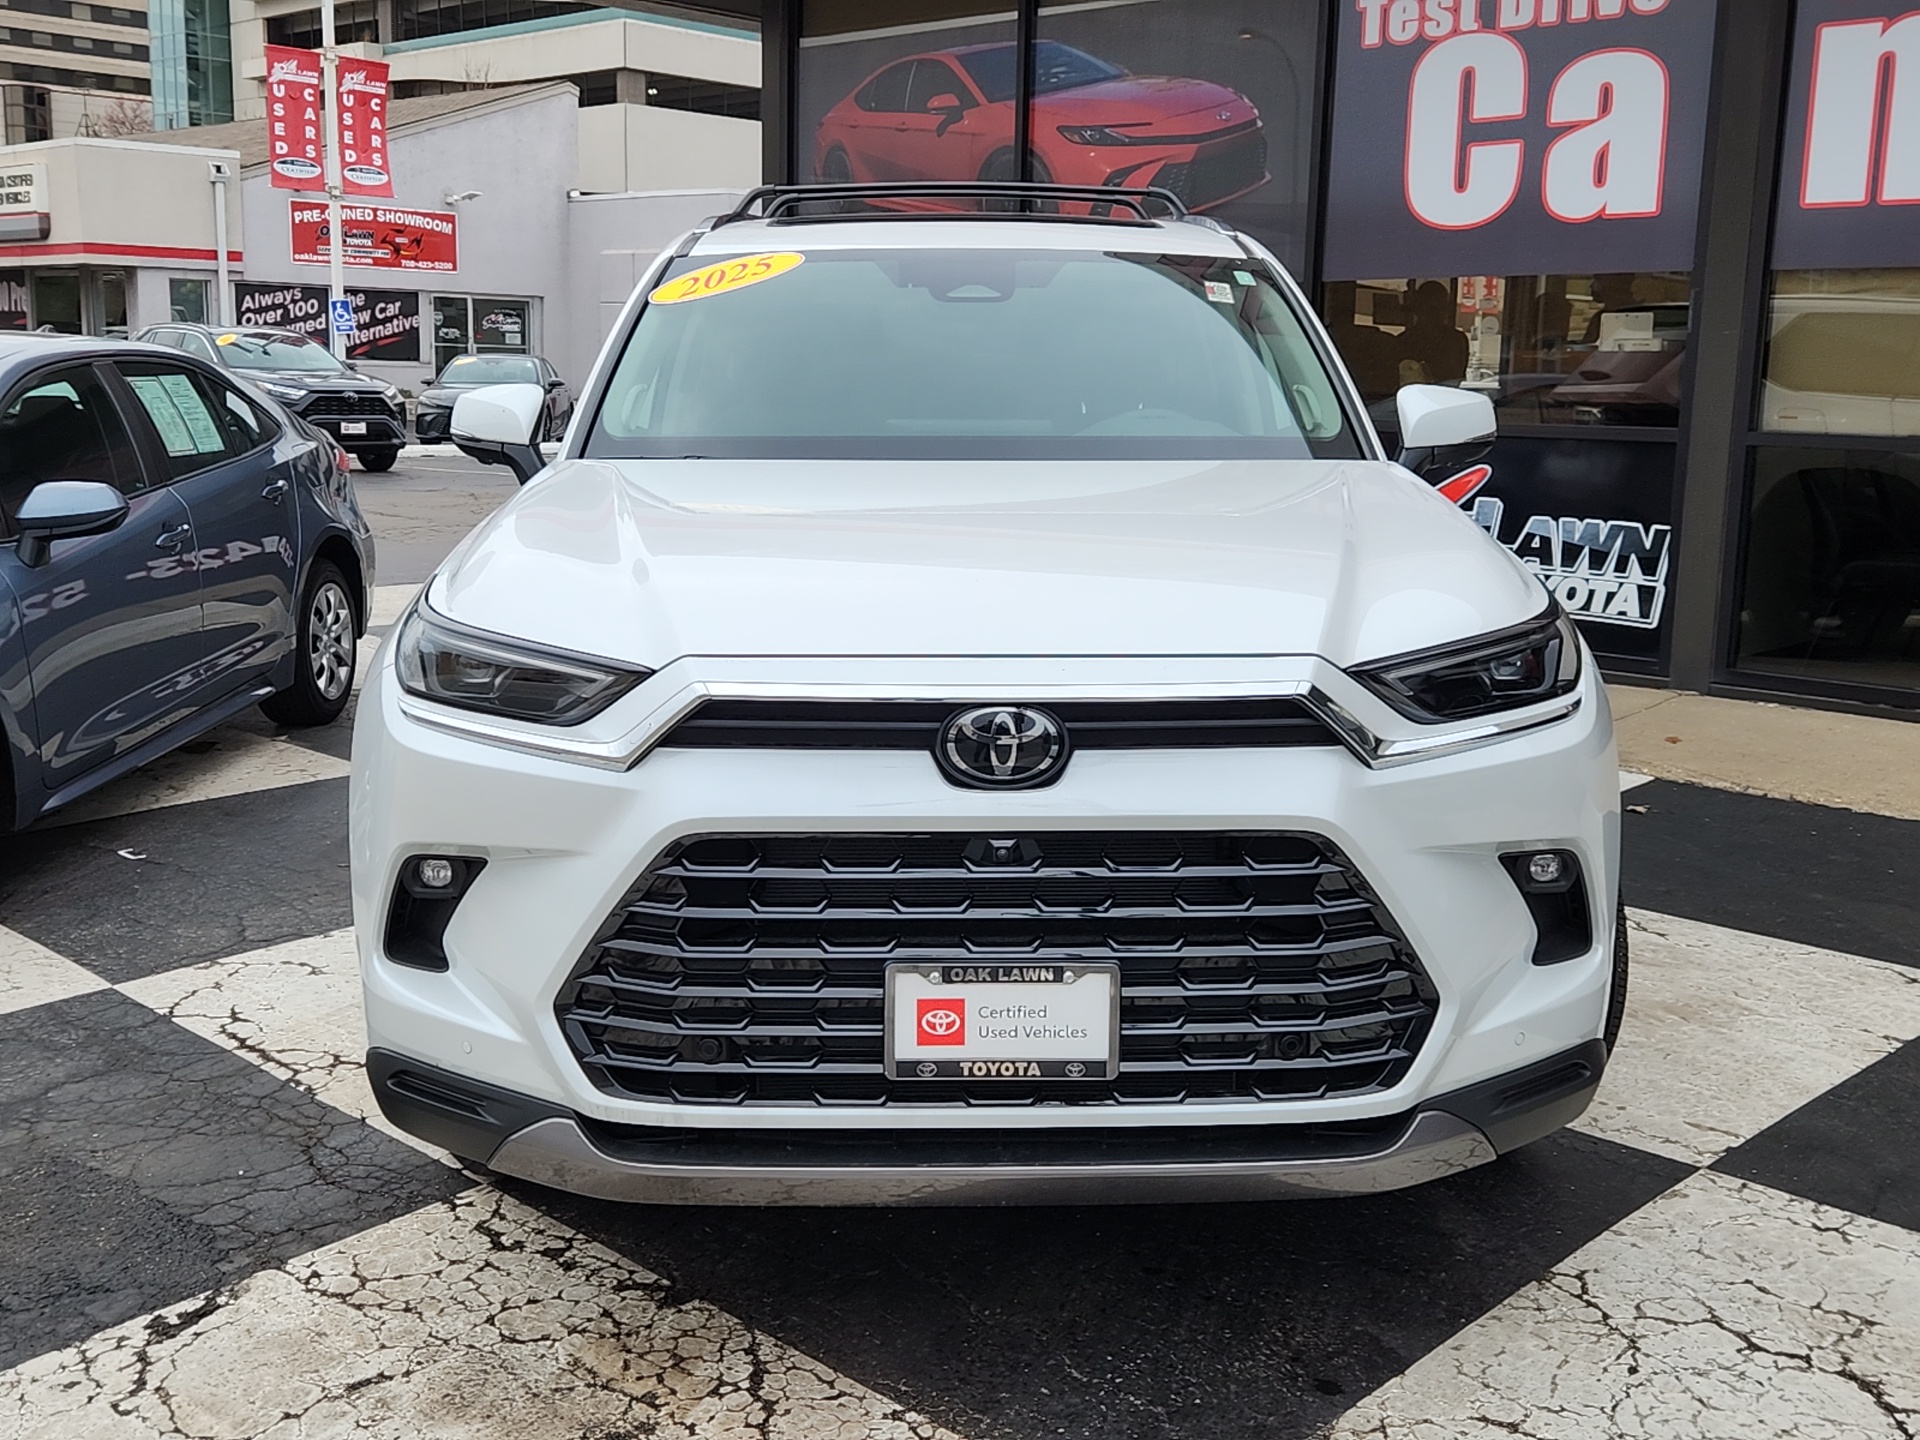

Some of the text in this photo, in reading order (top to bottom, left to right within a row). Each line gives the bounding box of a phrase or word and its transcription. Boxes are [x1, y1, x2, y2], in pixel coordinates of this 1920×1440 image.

[1357, 0, 1670, 47] Test Dri
[272, 83, 289, 155] USED
[303, 88, 317, 158] CARS
[342, 93, 357, 163] USED
[370, 98, 383, 167] CARS
[376, 210, 453, 235] SHOWROOM
[677, 255, 774, 299] 2025
[241, 288, 302, 311] Always
[242, 298, 319, 326] Over 100
[344, 292, 366, 307] he
[352, 300, 401, 326] ew Car
[1535, 574, 1642, 619] OTA
[950, 968, 1055, 982] OAK LAWN
[978, 1005, 1048, 1019] Certified
[978, 1026, 1088, 1039] Used Vehicles
[960, 1062, 1041, 1076] TOYOTA
